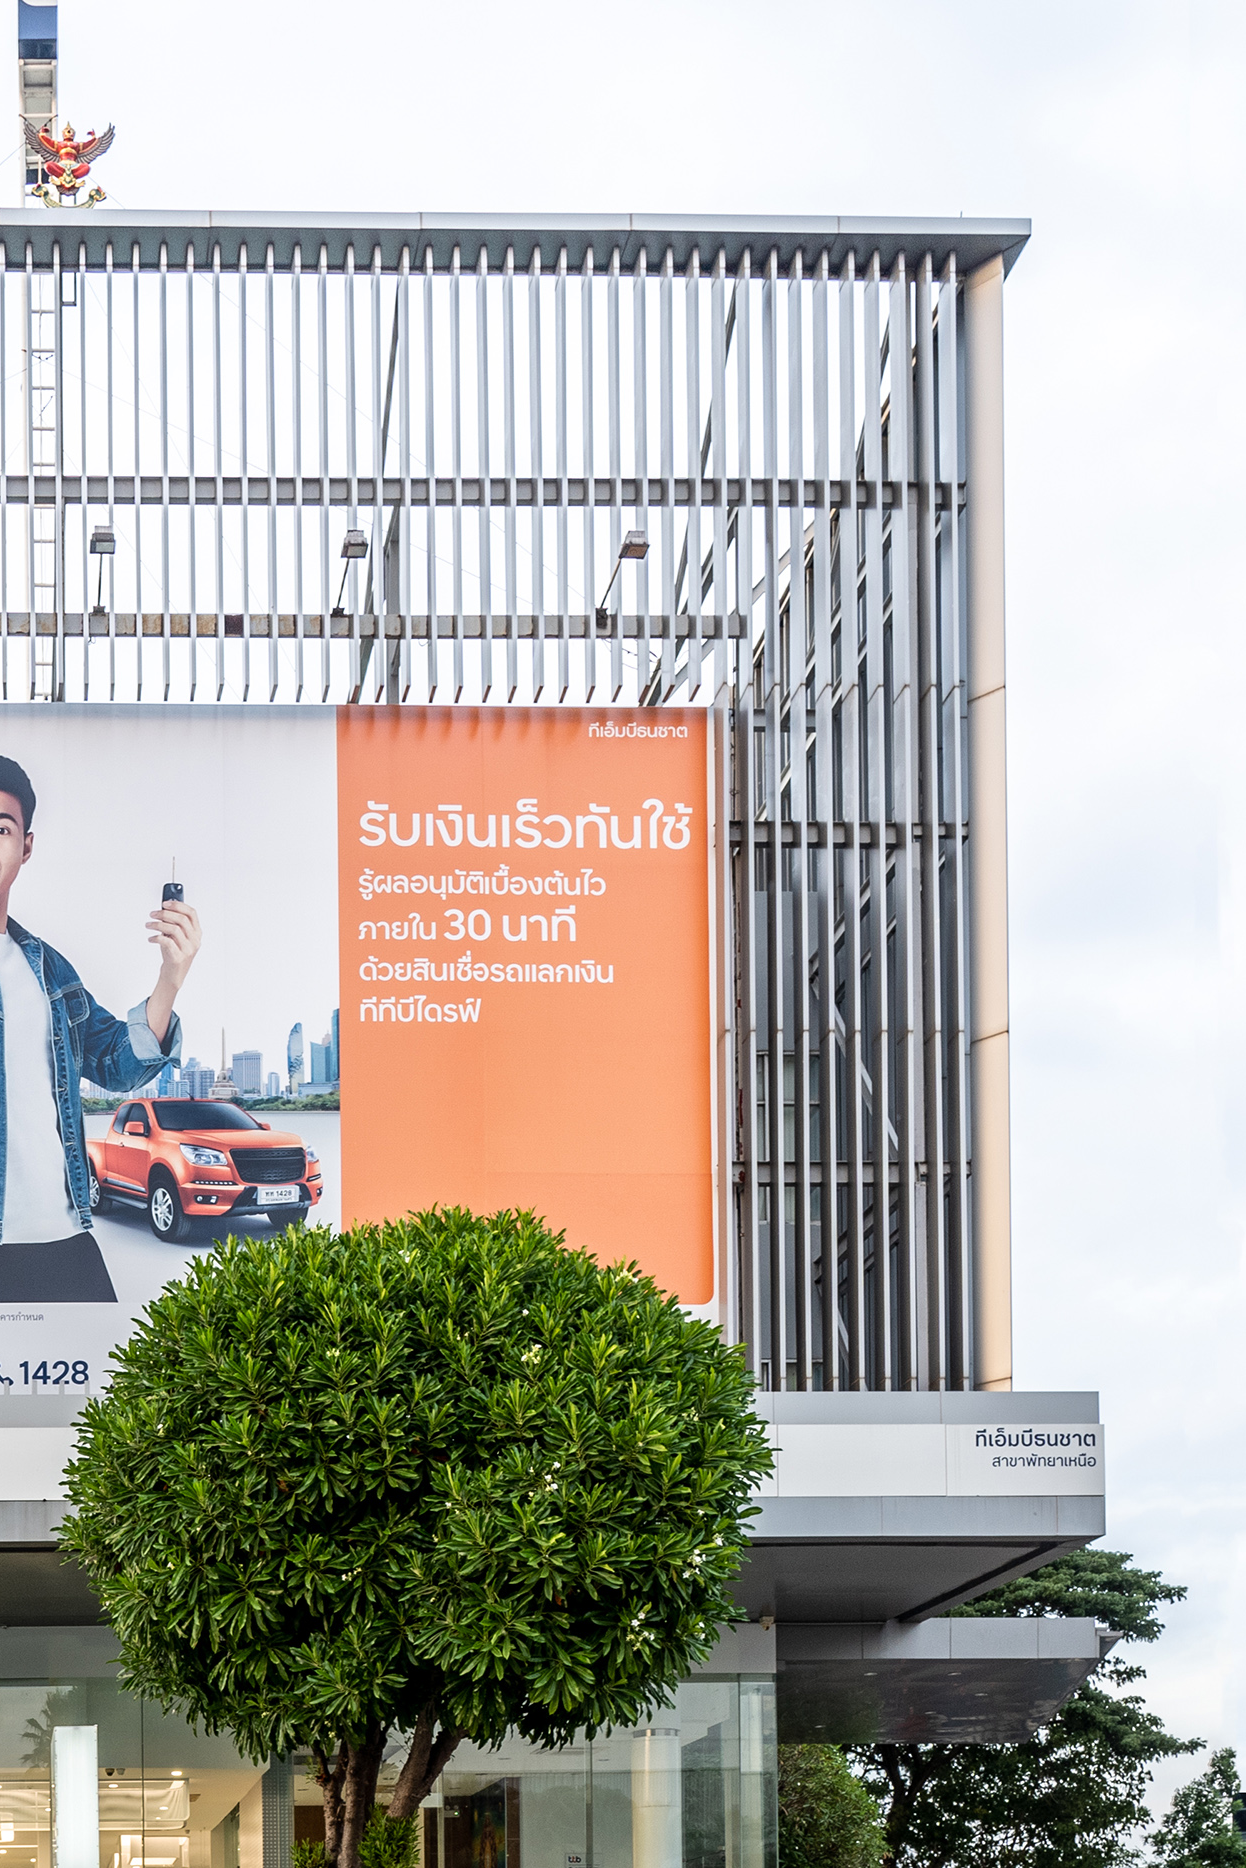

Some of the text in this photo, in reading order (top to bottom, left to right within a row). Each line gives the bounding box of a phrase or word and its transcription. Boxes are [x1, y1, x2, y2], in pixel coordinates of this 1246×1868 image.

[588, 721, 689, 738] ทีเอ็มบีธนชาต
[358, 797, 693, 850] รับเงินเร็วทันใช้
[358, 864, 607, 901] รู้ผลอนุมัติเบื้องต้นไว
[358, 905, 577, 942] ภายใน 30 นาที
[359, 950, 614, 984] ด้วยสินเชื่อรถแลกเงิน
[360, 995, 482, 1023] ทีทีบีไดรฟ์
[19, 1360, 90, 1385] 1428
[975, 1428, 1096, 1447] ทีเอ็มบีธนชาต
[992, 1453, 1097, 1467] สาขาพัทยาเหนือ
